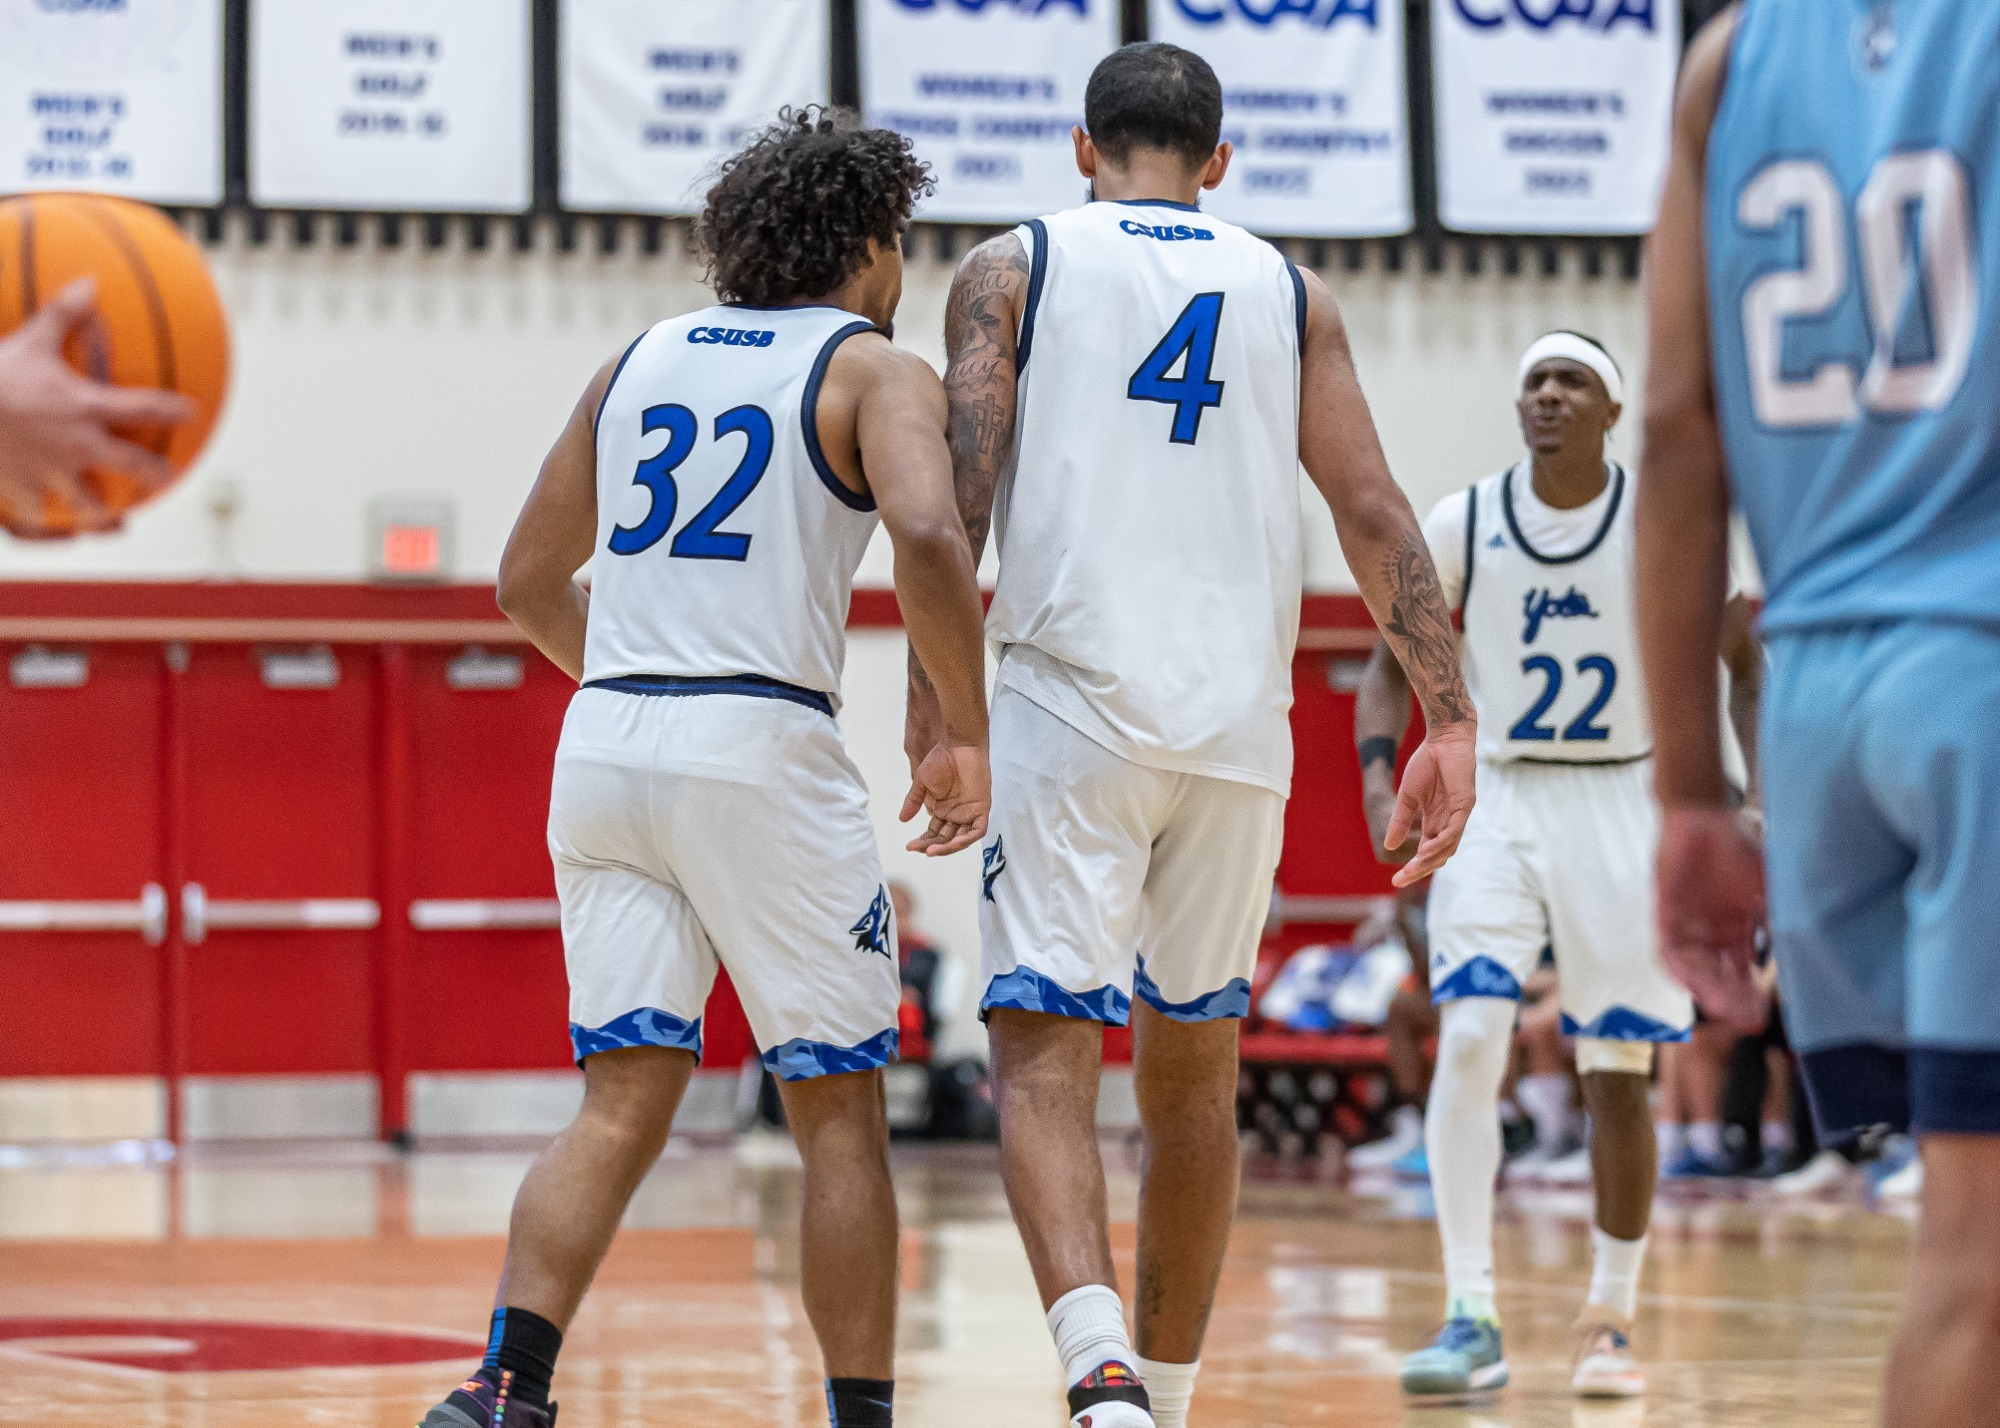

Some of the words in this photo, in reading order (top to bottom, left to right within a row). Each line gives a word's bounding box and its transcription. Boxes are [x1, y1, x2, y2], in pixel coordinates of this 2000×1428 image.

[1119, 219, 1216, 241] CSUSB
[1735, 145, 1980, 430] 20
[686, 326, 776, 348] CSUSB
[1126, 291, 1226, 446] 4
[607, 402, 774, 562] 32
[1507, 654, 1618, 742] 22
